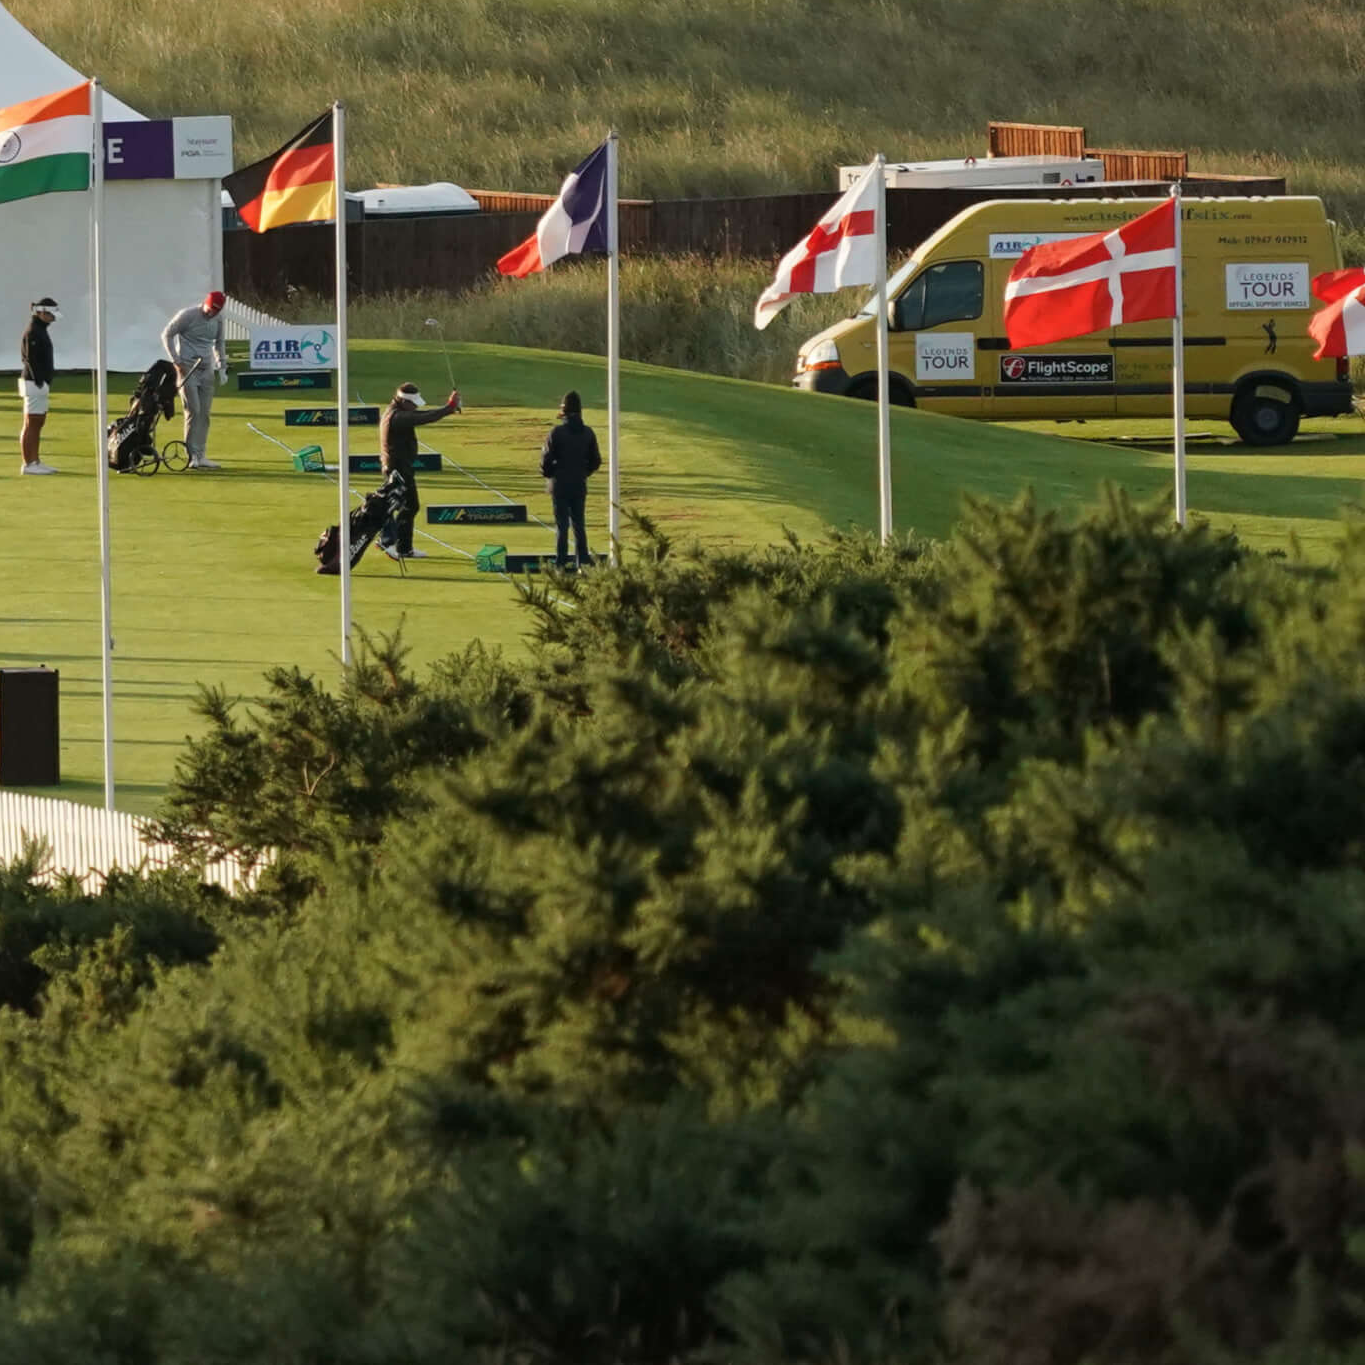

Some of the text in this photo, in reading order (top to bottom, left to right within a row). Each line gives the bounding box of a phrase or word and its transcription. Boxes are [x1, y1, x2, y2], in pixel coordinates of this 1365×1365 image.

[1243, 273, 1294, 281] LEGENDS
[1239, 282, 1295, 299] TOUR
[255, 339, 300, 352] A1R
[924, 348, 969, 356] LEGENDS
[921, 356, 970, 372] TOUR
[1027, 360, 1110, 375] FlightScope
